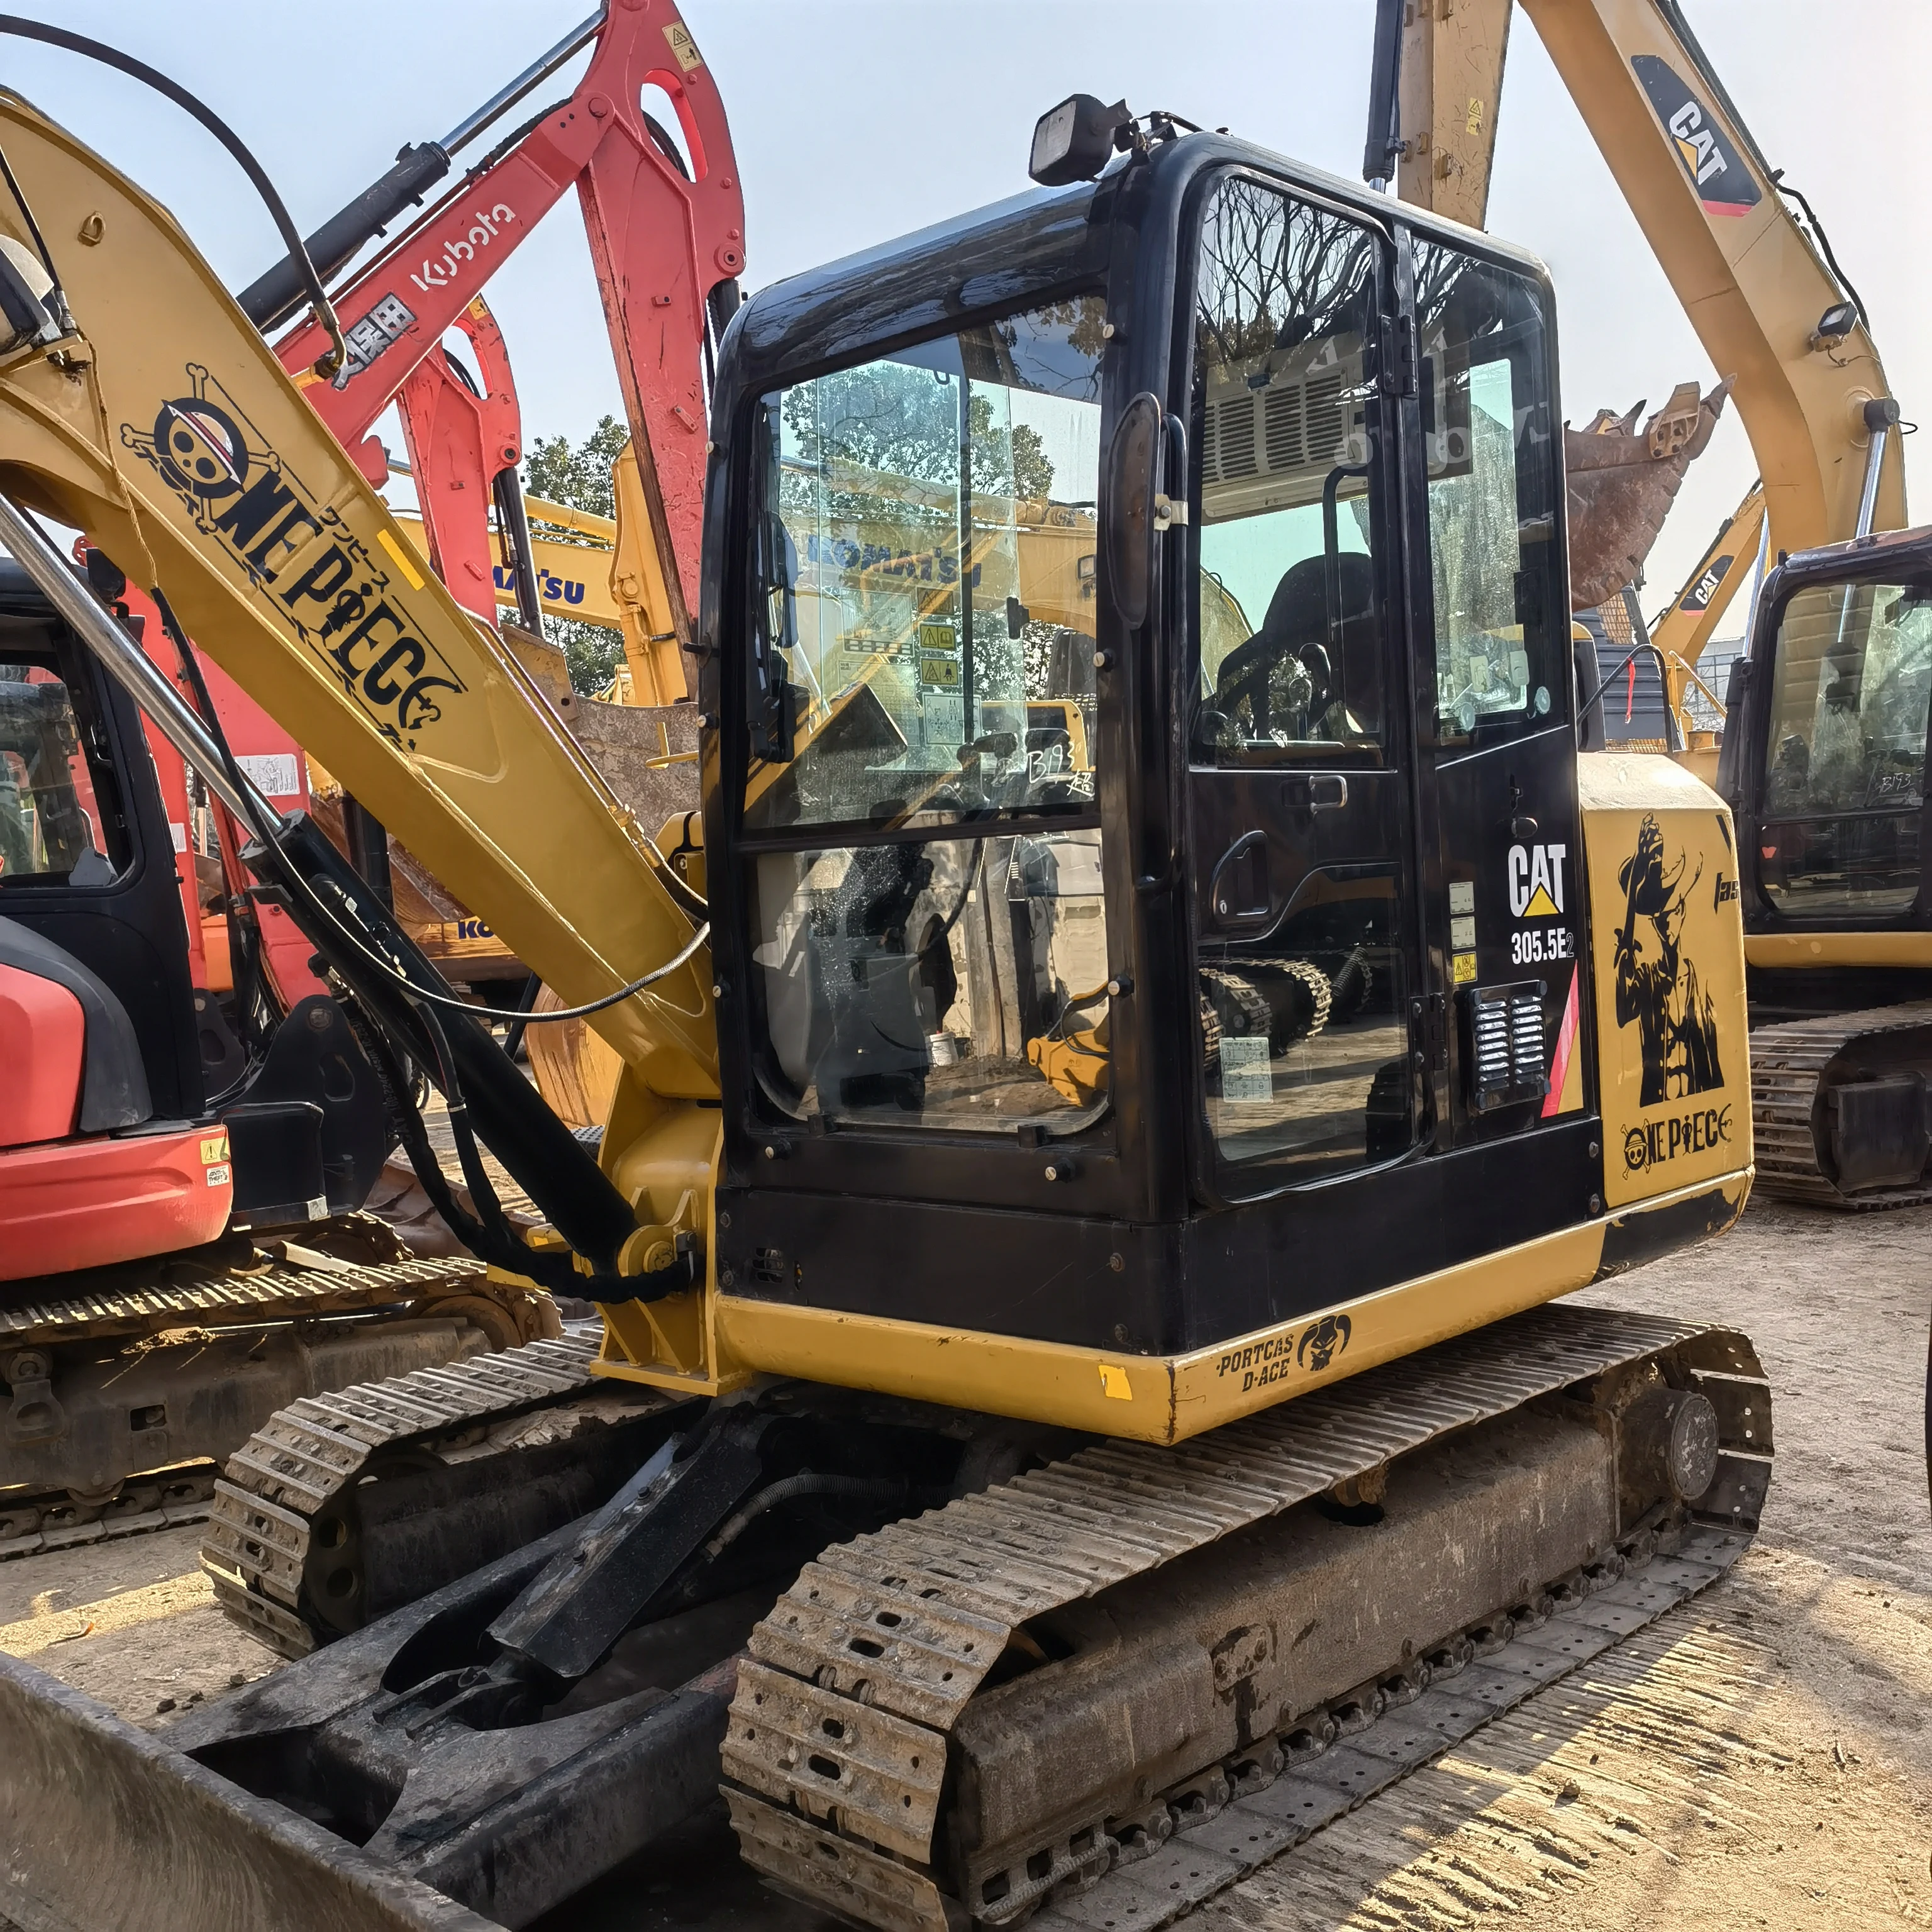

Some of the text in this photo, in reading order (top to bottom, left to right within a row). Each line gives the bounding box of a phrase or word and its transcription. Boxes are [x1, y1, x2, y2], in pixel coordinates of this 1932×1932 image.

[1670, 101, 1727, 186] CAT
[410, 203, 516, 291] Kubota
[1695, 569, 1719, 604] CAT
[1027, 741, 1075, 784] B193
[1508, 844, 1566, 918] CAT
[1623, 1103, 1733, 1172] ONE PIECE
